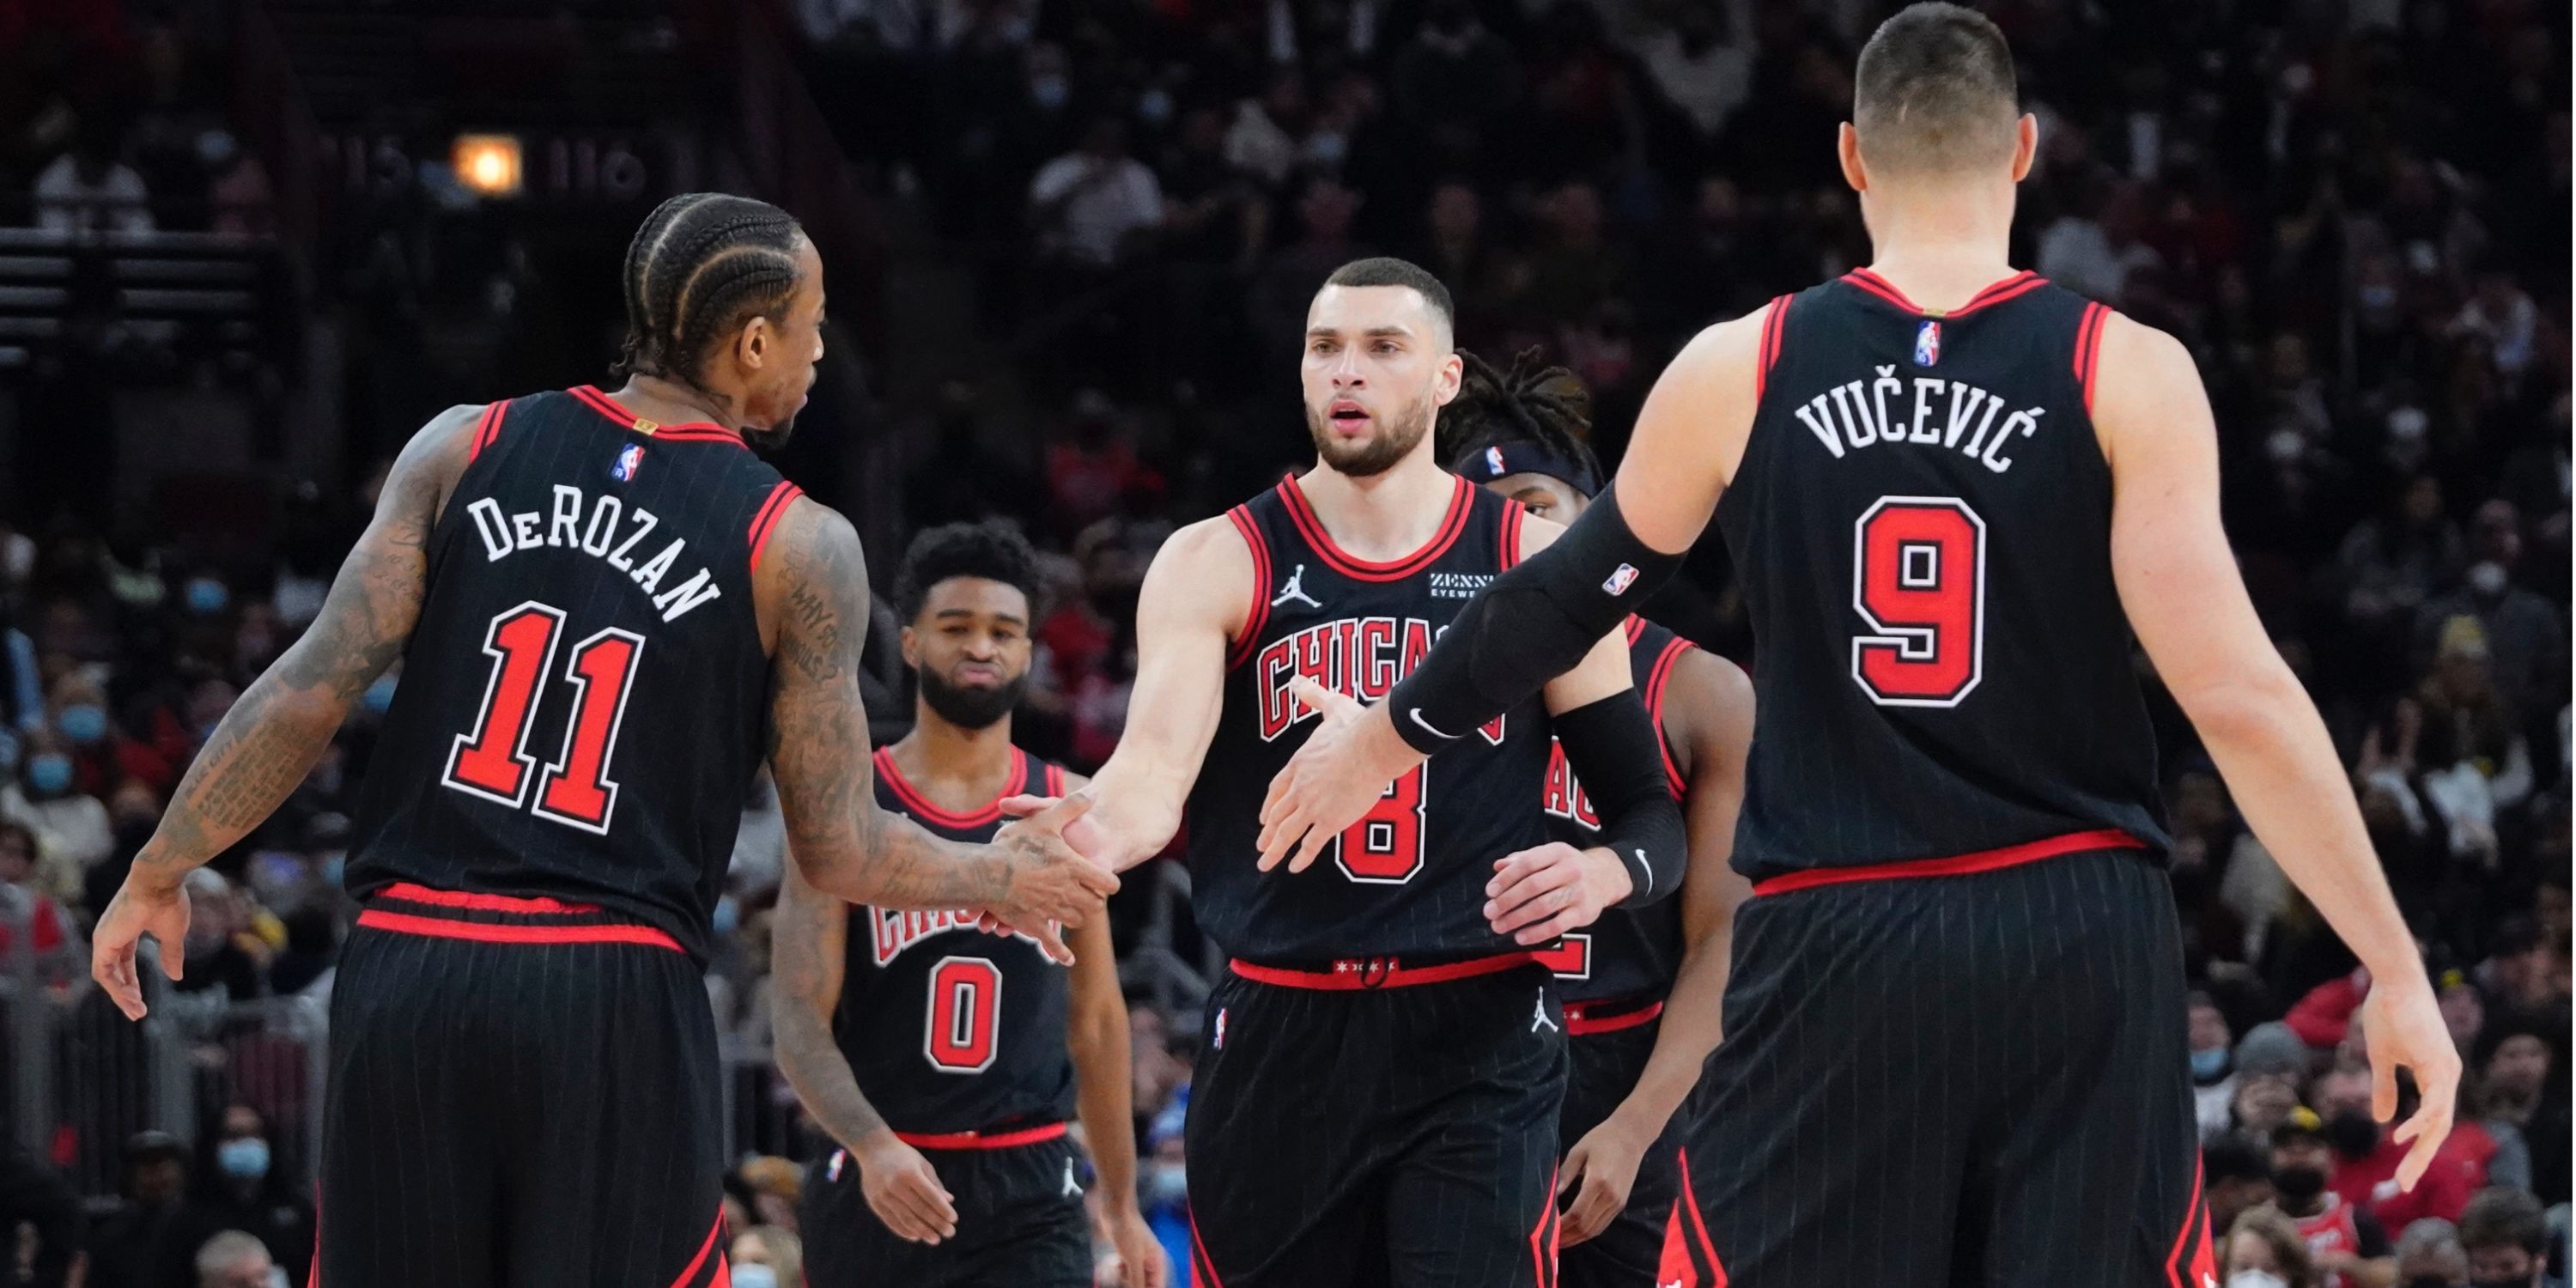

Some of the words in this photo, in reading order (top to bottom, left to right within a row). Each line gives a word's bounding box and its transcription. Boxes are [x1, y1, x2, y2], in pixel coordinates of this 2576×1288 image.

[1795, 364, 2045, 473] VUČEVIĆ
[1431, 589, 1475, 598] EYEWE
[1852, 495, 1986, 708] 9
[441, 600, 646, 835] 11
[1257, 617, 1505, 746] CHICA
[1335, 758, 1428, 884] 8
[923, 956, 1002, 1073] 0
